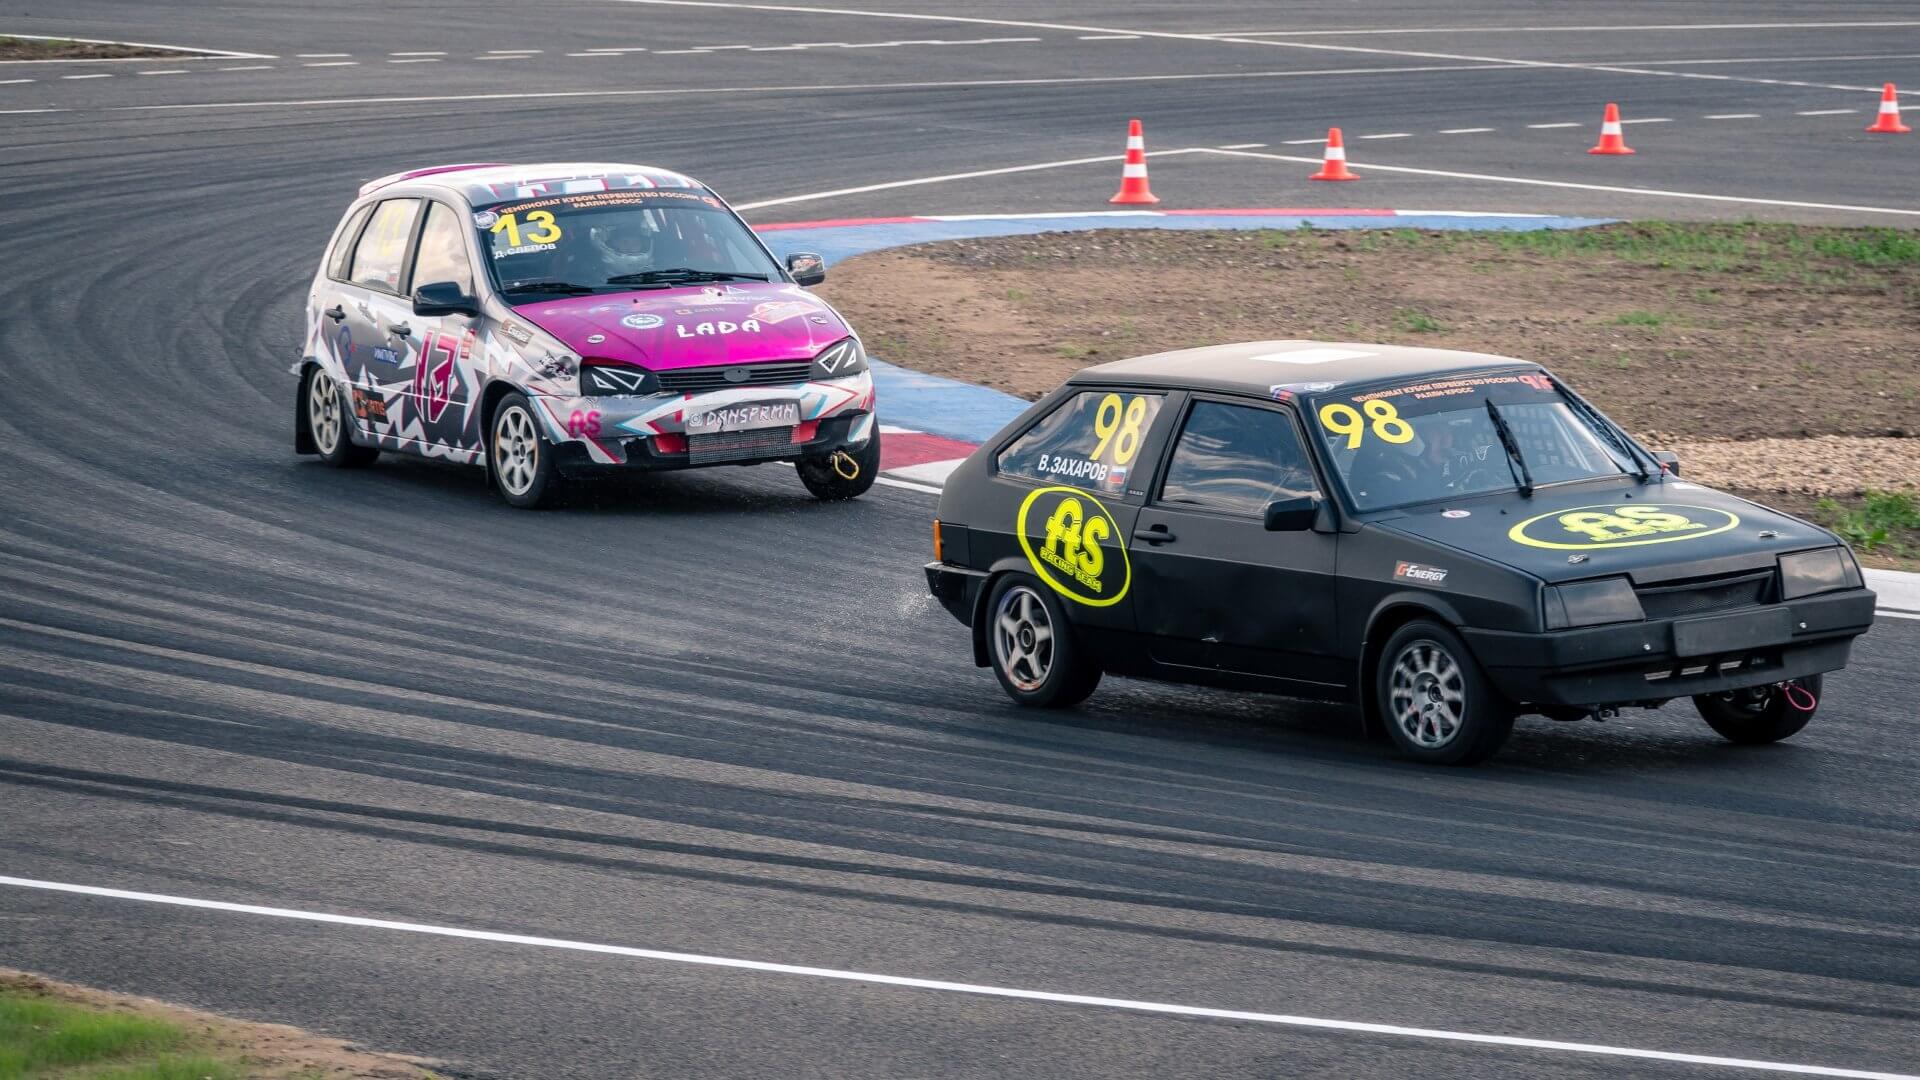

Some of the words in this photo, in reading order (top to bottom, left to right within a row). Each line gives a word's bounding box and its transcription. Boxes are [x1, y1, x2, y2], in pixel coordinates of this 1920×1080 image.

[500, 198, 561, 214] ЧЕМПИОНАТ
[562, 194, 596, 204] КУБОК
[597, 191, 658, 201] ПЕРВЕНСТВО
[659, 192, 699, 201] РОССИИ
[573, 198, 643, 209] РАЛЛИ-КРОСС
[490, 210, 562, 247] 13
[494, 243, 557, 259] Д.СЛЕПОВ
[676, 319, 761, 338] LADA
[567, 409, 602, 438] AS
[1090, 393, 1147, 464] 98
[1319, 399, 1415, 449] 98
[1038, 454, 1108, 481] В.ЗАХАРОВ
[1045, 497, 1110, 577] AS
[1559, 506, 1689, 539] AS
[1039, 547, 1076, 576] RACING
[1075, 567, 1102, 593] TEAM
[1397, 563, 1447, 582] G-ENERGY
